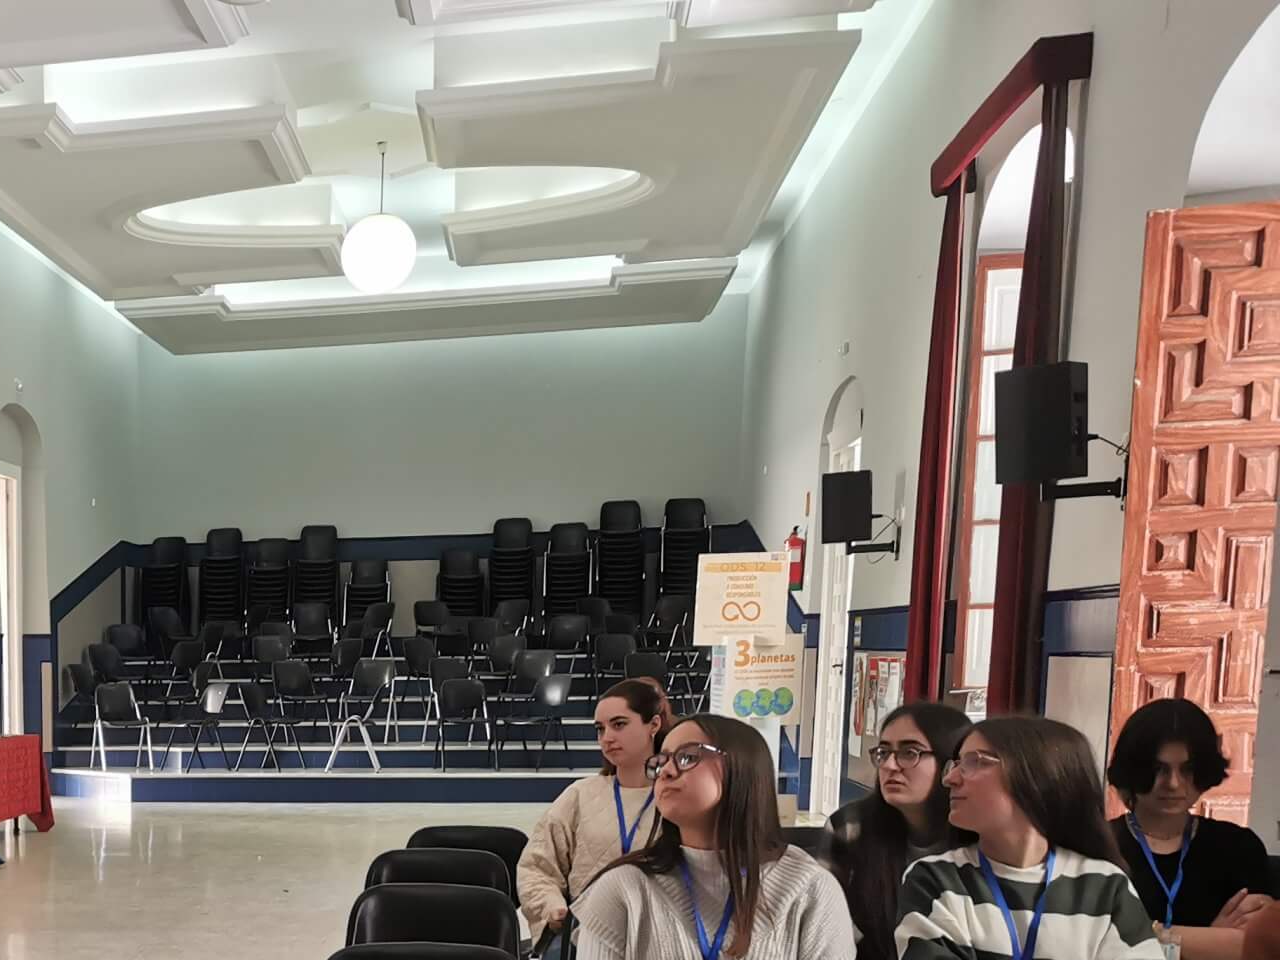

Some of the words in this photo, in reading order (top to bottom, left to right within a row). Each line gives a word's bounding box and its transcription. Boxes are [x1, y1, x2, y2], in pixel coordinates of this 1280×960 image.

[719, 562, 746, 572] ODS
[754, 561, 766, 571] 12
[734, 639, 751, 667] 3
[751, 653, 795, 665] planetas
